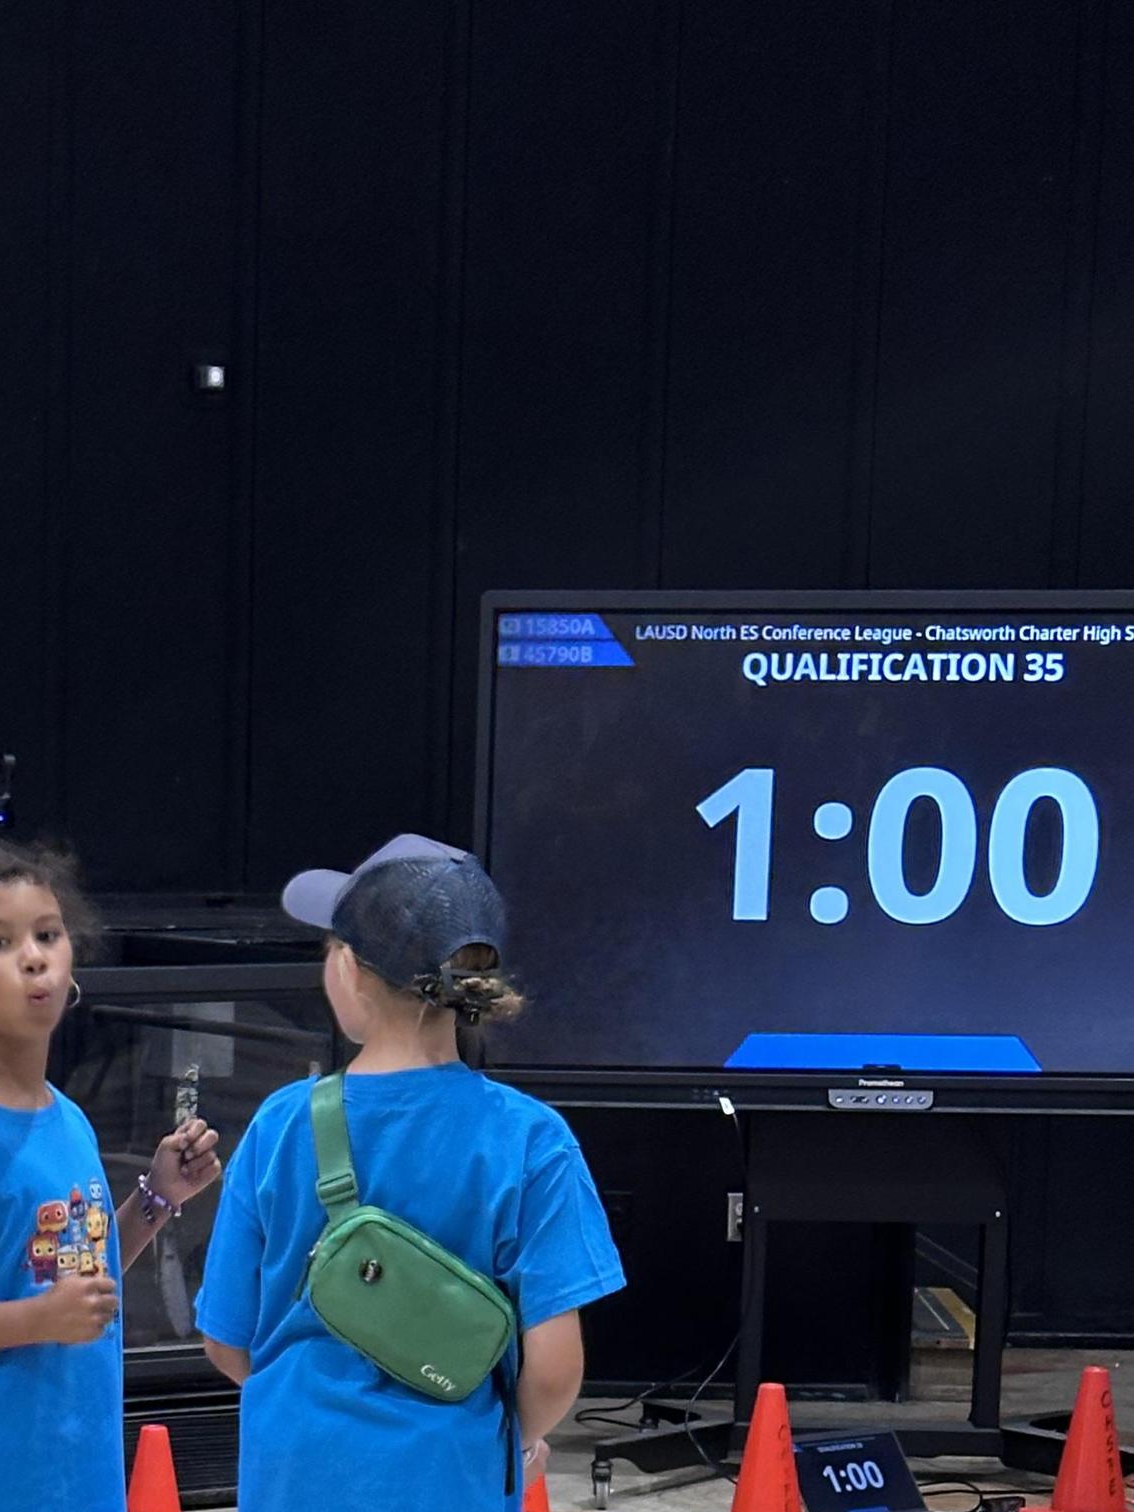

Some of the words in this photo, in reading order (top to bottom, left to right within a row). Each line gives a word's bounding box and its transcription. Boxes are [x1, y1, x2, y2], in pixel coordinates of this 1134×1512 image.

[526, 618, 596, 636] 15850A
[635, 624, 687, 641] LAUSD
[691, 624, 736, 640] North
[740, 625, 759, 640] ES
[762, 624, 851, 641] Conference
[854, 624, 912, 645] League
[925, 624, 1016, 642] Chatsworth
[1019, 625, 1080, 642] Charter
[1083, 625, 1121, 645] High
[742, 652, 1016, 686] QUALIFICATION
[1023, 652, 1065, 682] 35
[696, 767, 1100, 926] 1:00
[822, 1460, 884, 1493] 1:00
